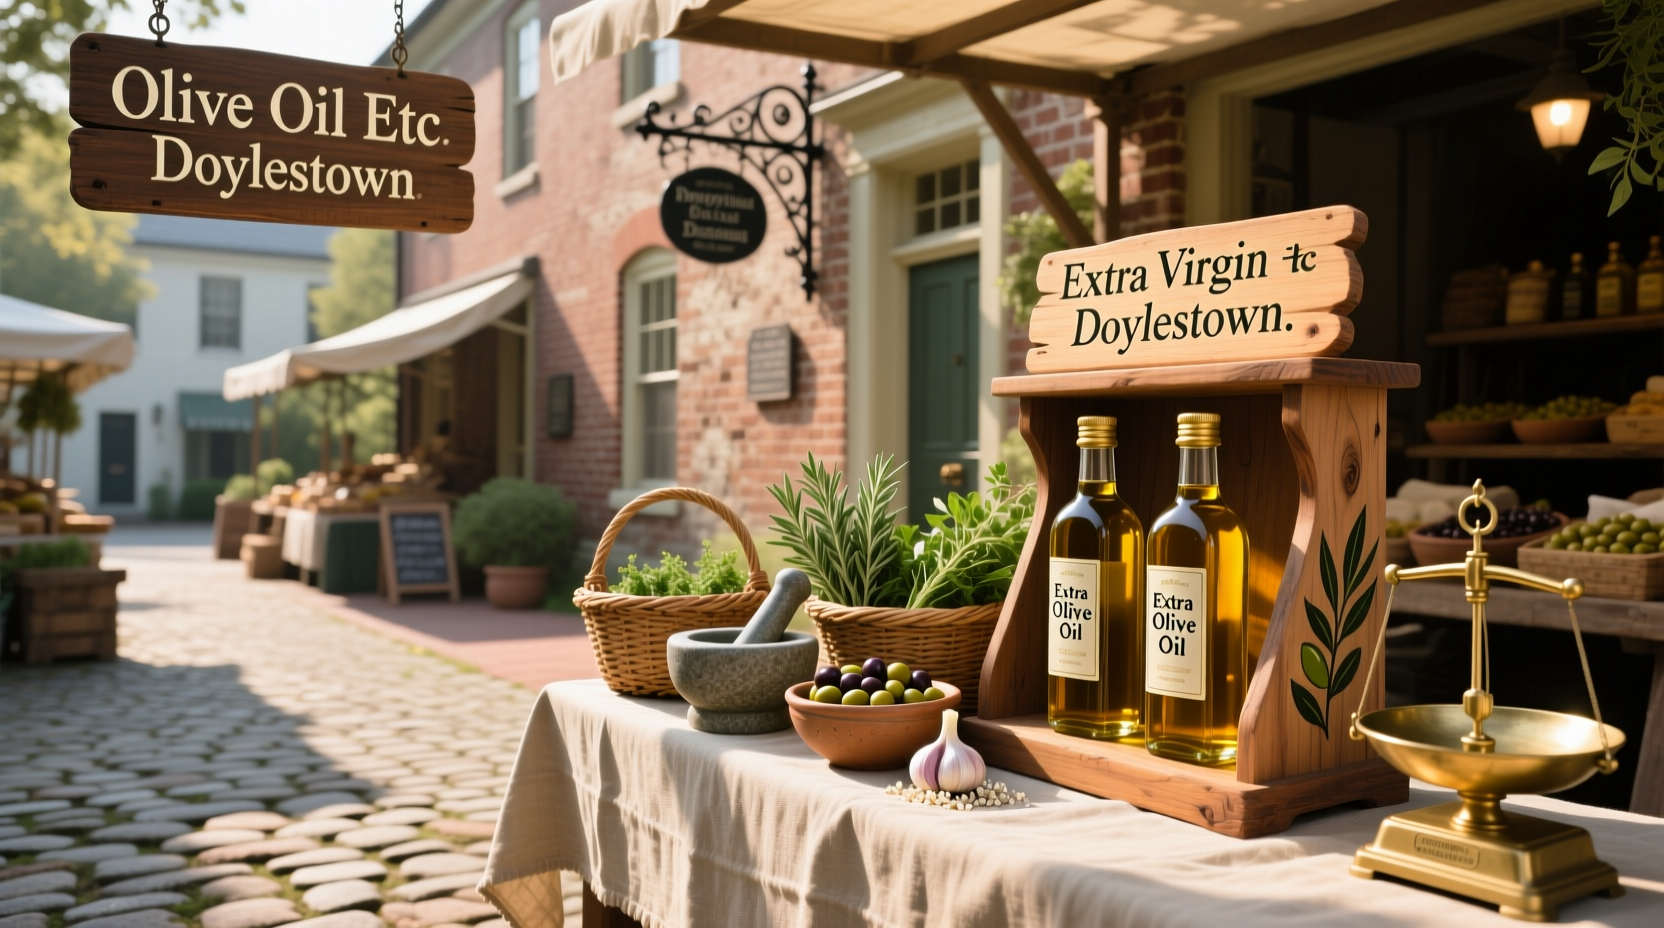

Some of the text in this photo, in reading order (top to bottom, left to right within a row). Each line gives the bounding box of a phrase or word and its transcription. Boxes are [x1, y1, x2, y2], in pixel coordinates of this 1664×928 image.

[112, 66, 449, 146] Olive Oil Etc.
[1060, 263, 1148, 300] Extra
[1158, 241, 1267, 294] Virgin
[1071, 302, 1293, 355] Doylestown.
[1055, 583, 1088, 600] Extra
[1154, 593, 1193, 611] Extra
[1053, 601, 1092, 620] Olive
[1060, 622, 1082, 640] Oil
[1153, 612, 1196, 633] Olive
[1159, 635, 1185, 656] Oil
